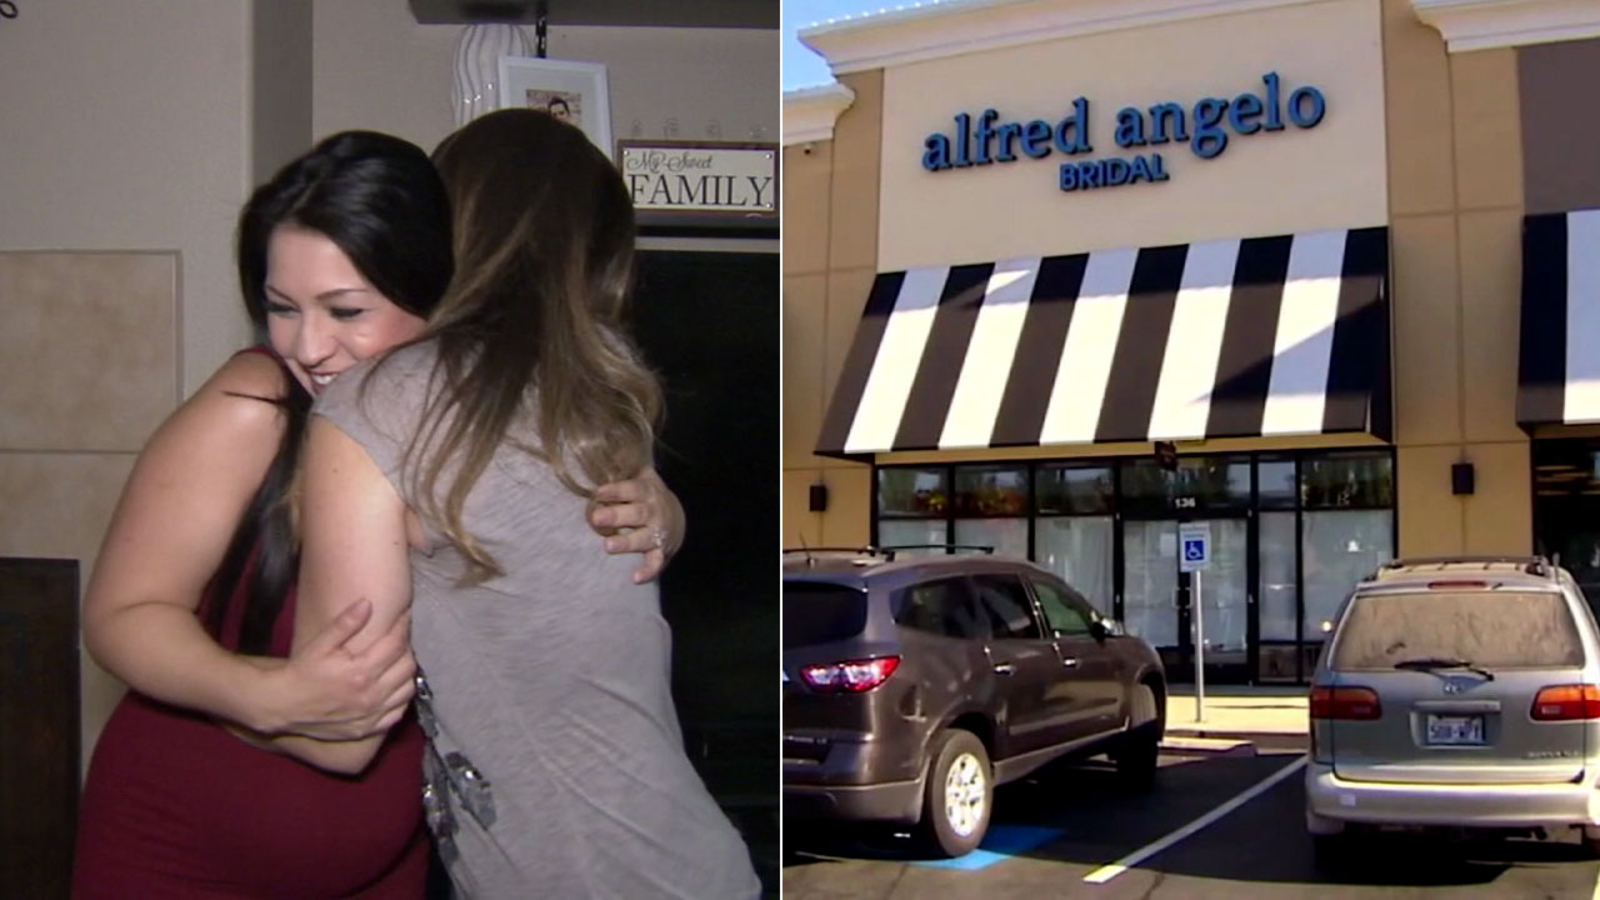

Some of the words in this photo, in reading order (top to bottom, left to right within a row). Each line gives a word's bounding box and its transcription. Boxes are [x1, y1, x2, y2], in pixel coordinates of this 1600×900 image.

[922, 96, 1093, 172] alfred
[1114, 71, 1326, 160] angelo
[626, 151, 665, 174] My
[664, 151, 713, 172] Sweet
[1060, 154, 1170, 191] BRIDAL
[628, 174, 772, 207] FAMILY
